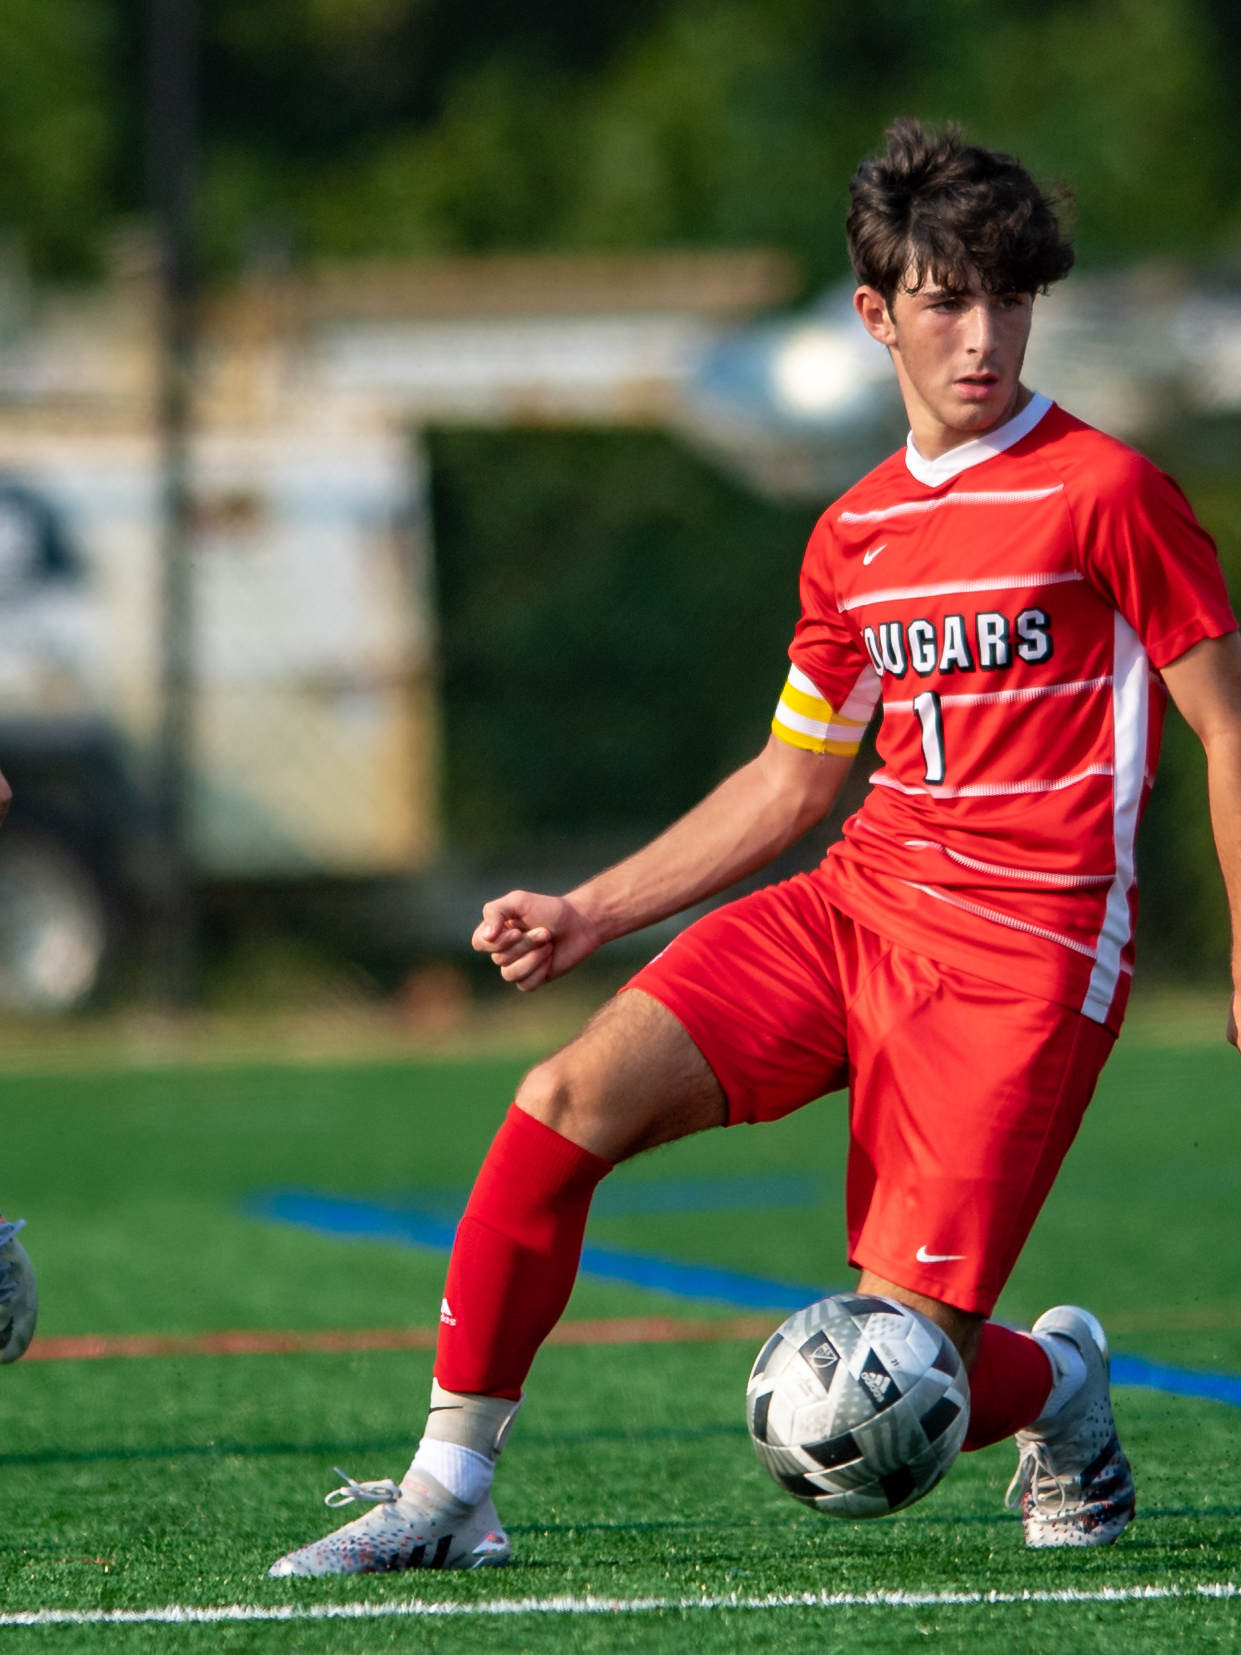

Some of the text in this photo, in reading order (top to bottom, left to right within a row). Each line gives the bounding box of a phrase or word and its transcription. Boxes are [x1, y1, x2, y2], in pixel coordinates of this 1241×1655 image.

[861, 606, 1054, 680] OUGARS
[913, 690, 946, 786] 1
[861, 1371, 885, 1403] adidas
